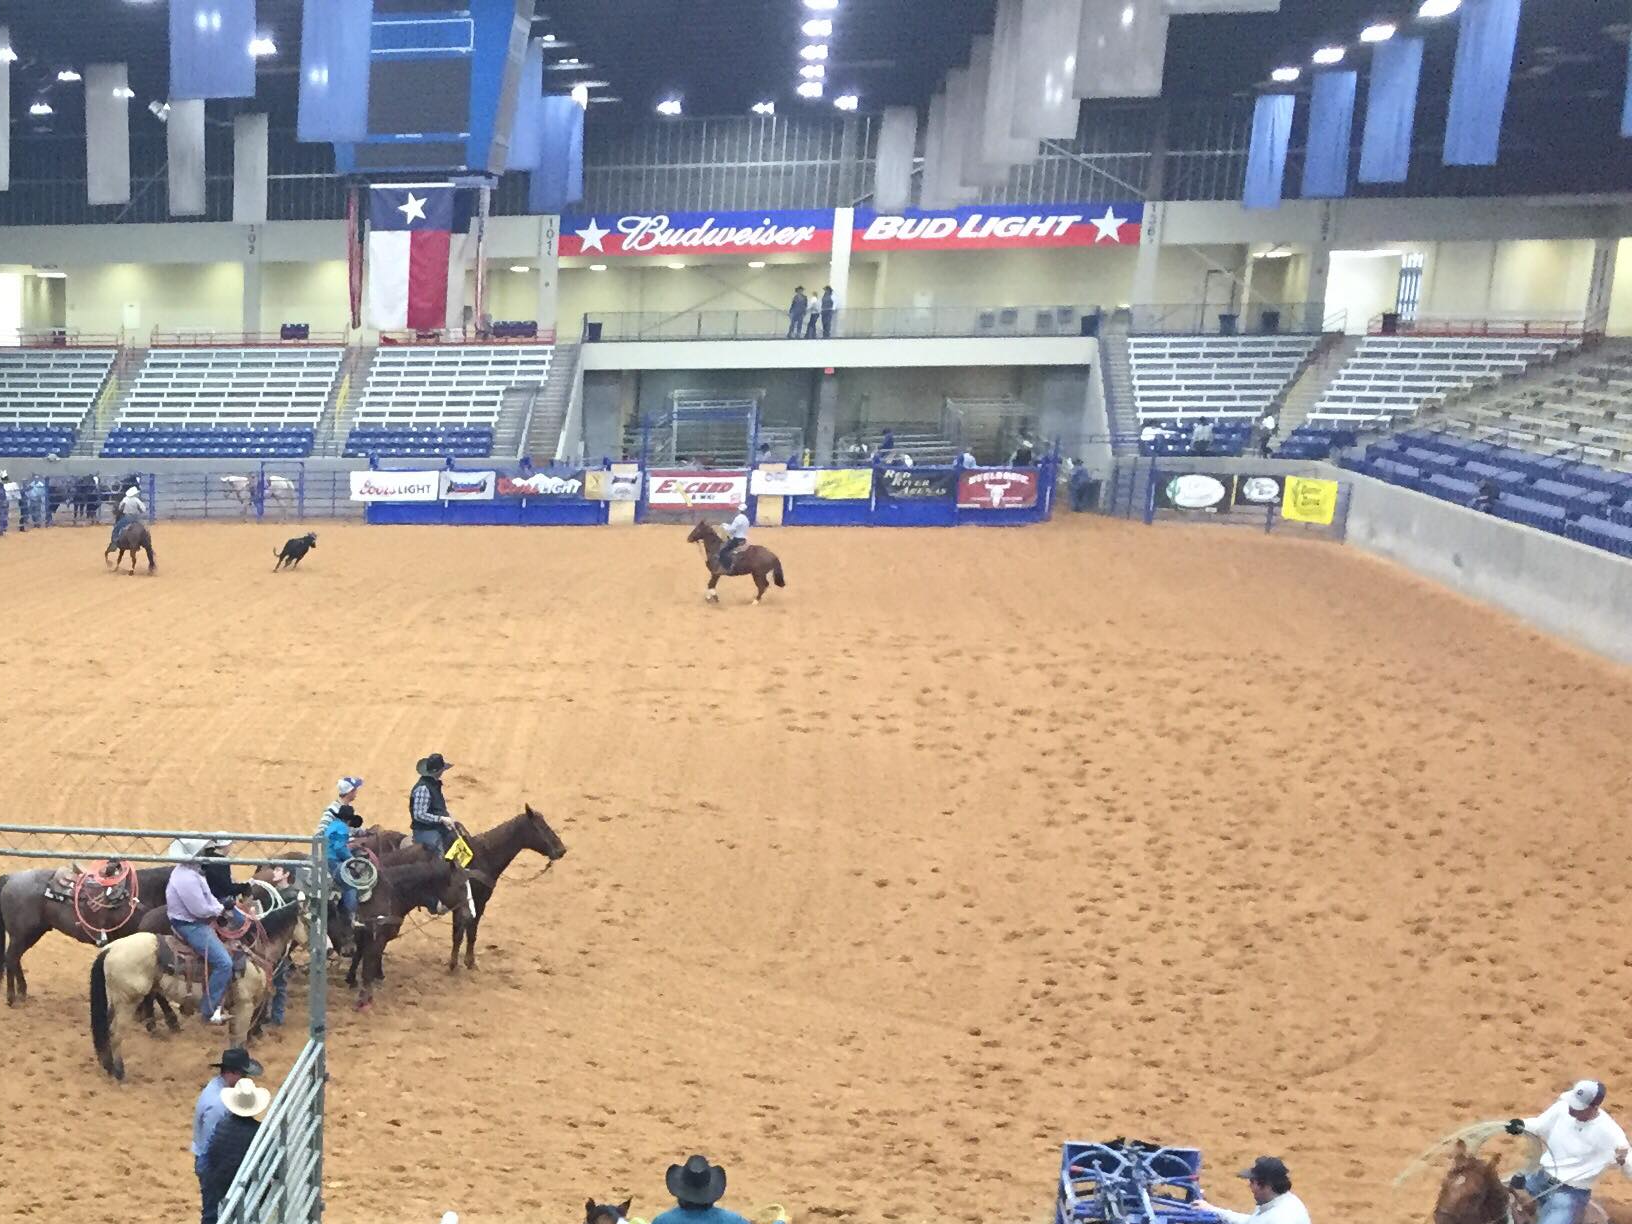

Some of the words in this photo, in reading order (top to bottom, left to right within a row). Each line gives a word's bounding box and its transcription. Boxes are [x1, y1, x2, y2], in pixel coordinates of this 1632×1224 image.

[247, 223, 257, 255] 102
[618, 215, 815, 251] Budweiser
[862, 215, 959, 240] BUD
[957, 213, 1082, 239] LIGHT
[359, 480, 397, 496] Coors
[398, 483, 432, 495] LIGHT
[538, 481, 582, 494] LIGHT
